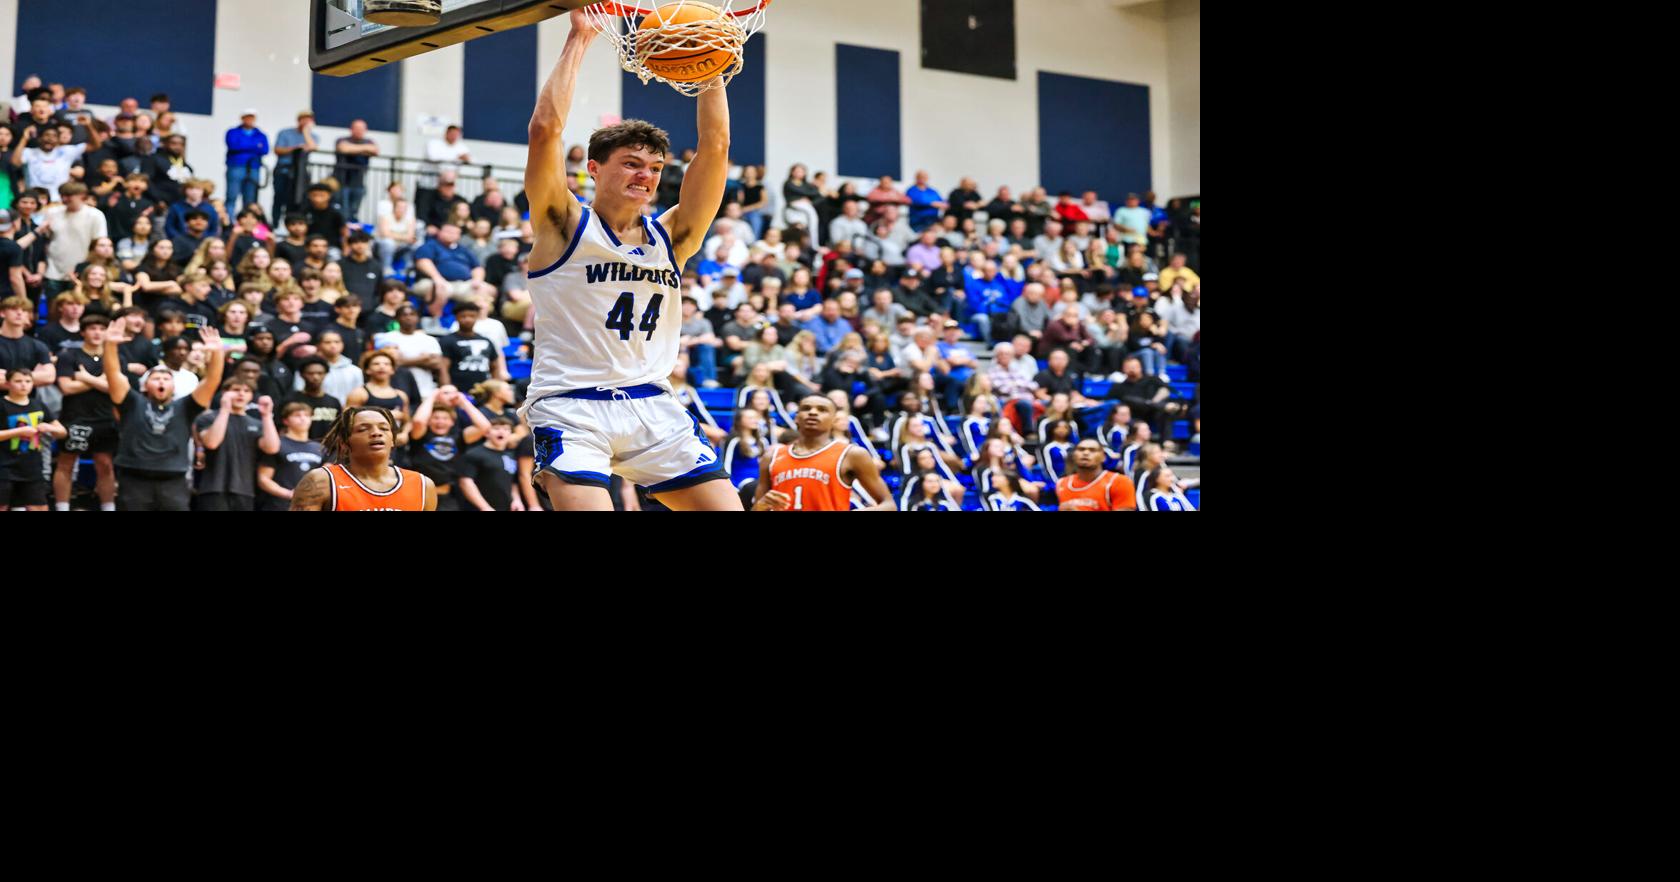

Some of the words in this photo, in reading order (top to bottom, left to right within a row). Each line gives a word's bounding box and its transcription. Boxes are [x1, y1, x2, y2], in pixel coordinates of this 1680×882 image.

[605, 291, 664, 341] 44
[773, 467, 831, 486] CHAMBERS
[793, 485, 803, 510] 1
